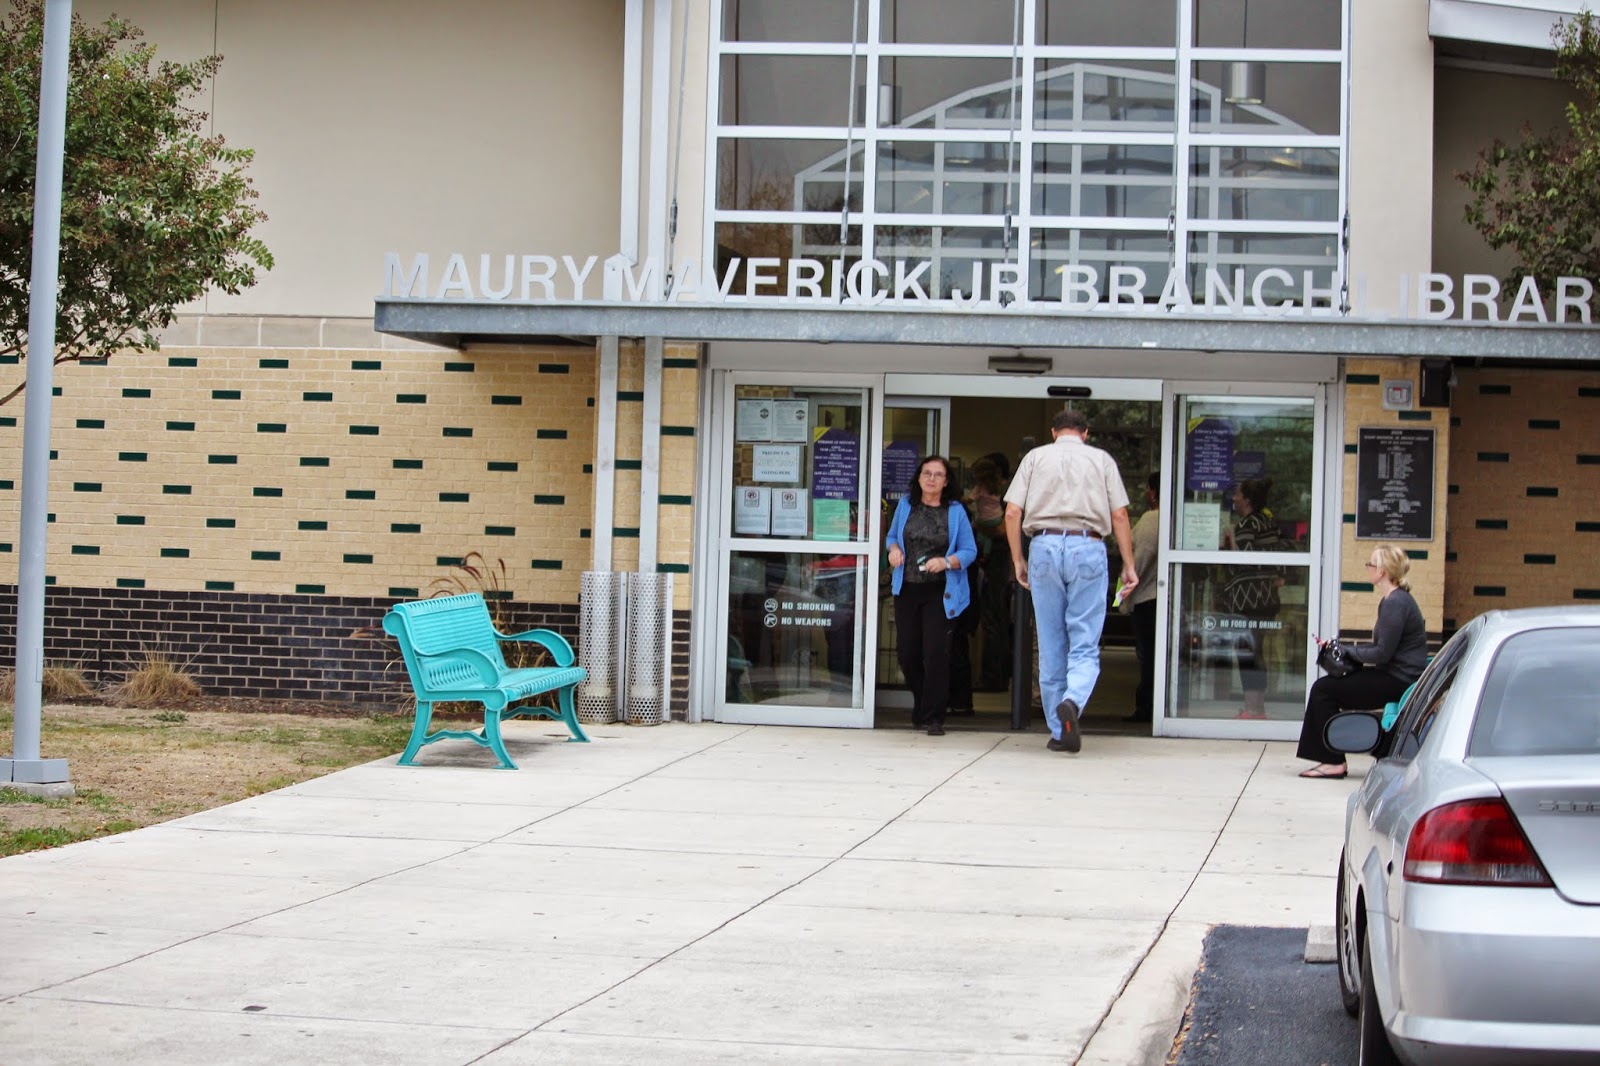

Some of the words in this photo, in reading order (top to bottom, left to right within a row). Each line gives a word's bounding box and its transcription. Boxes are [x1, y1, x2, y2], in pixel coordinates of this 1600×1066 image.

[384, 252, 599, 300] MAURY
[613, 255, 936, 305] MAVERICK
[952, 261, 1027, 309] JR
[1061, 265, 1341, 317] BRANCH
[1356, 272, 1600, 324] LIBRAR
[781, 602, 793, 610] NO
[797, 602, 835, 611] SMOKING
[781, 617, 792, 625] NO
[795, 617, 832, 627] WEAPONS
[1220, 619, 1229, 628] NO
[1231, 619, 1247, 629] FOOD
[1259, 620, 1282, 630] DRINKS
